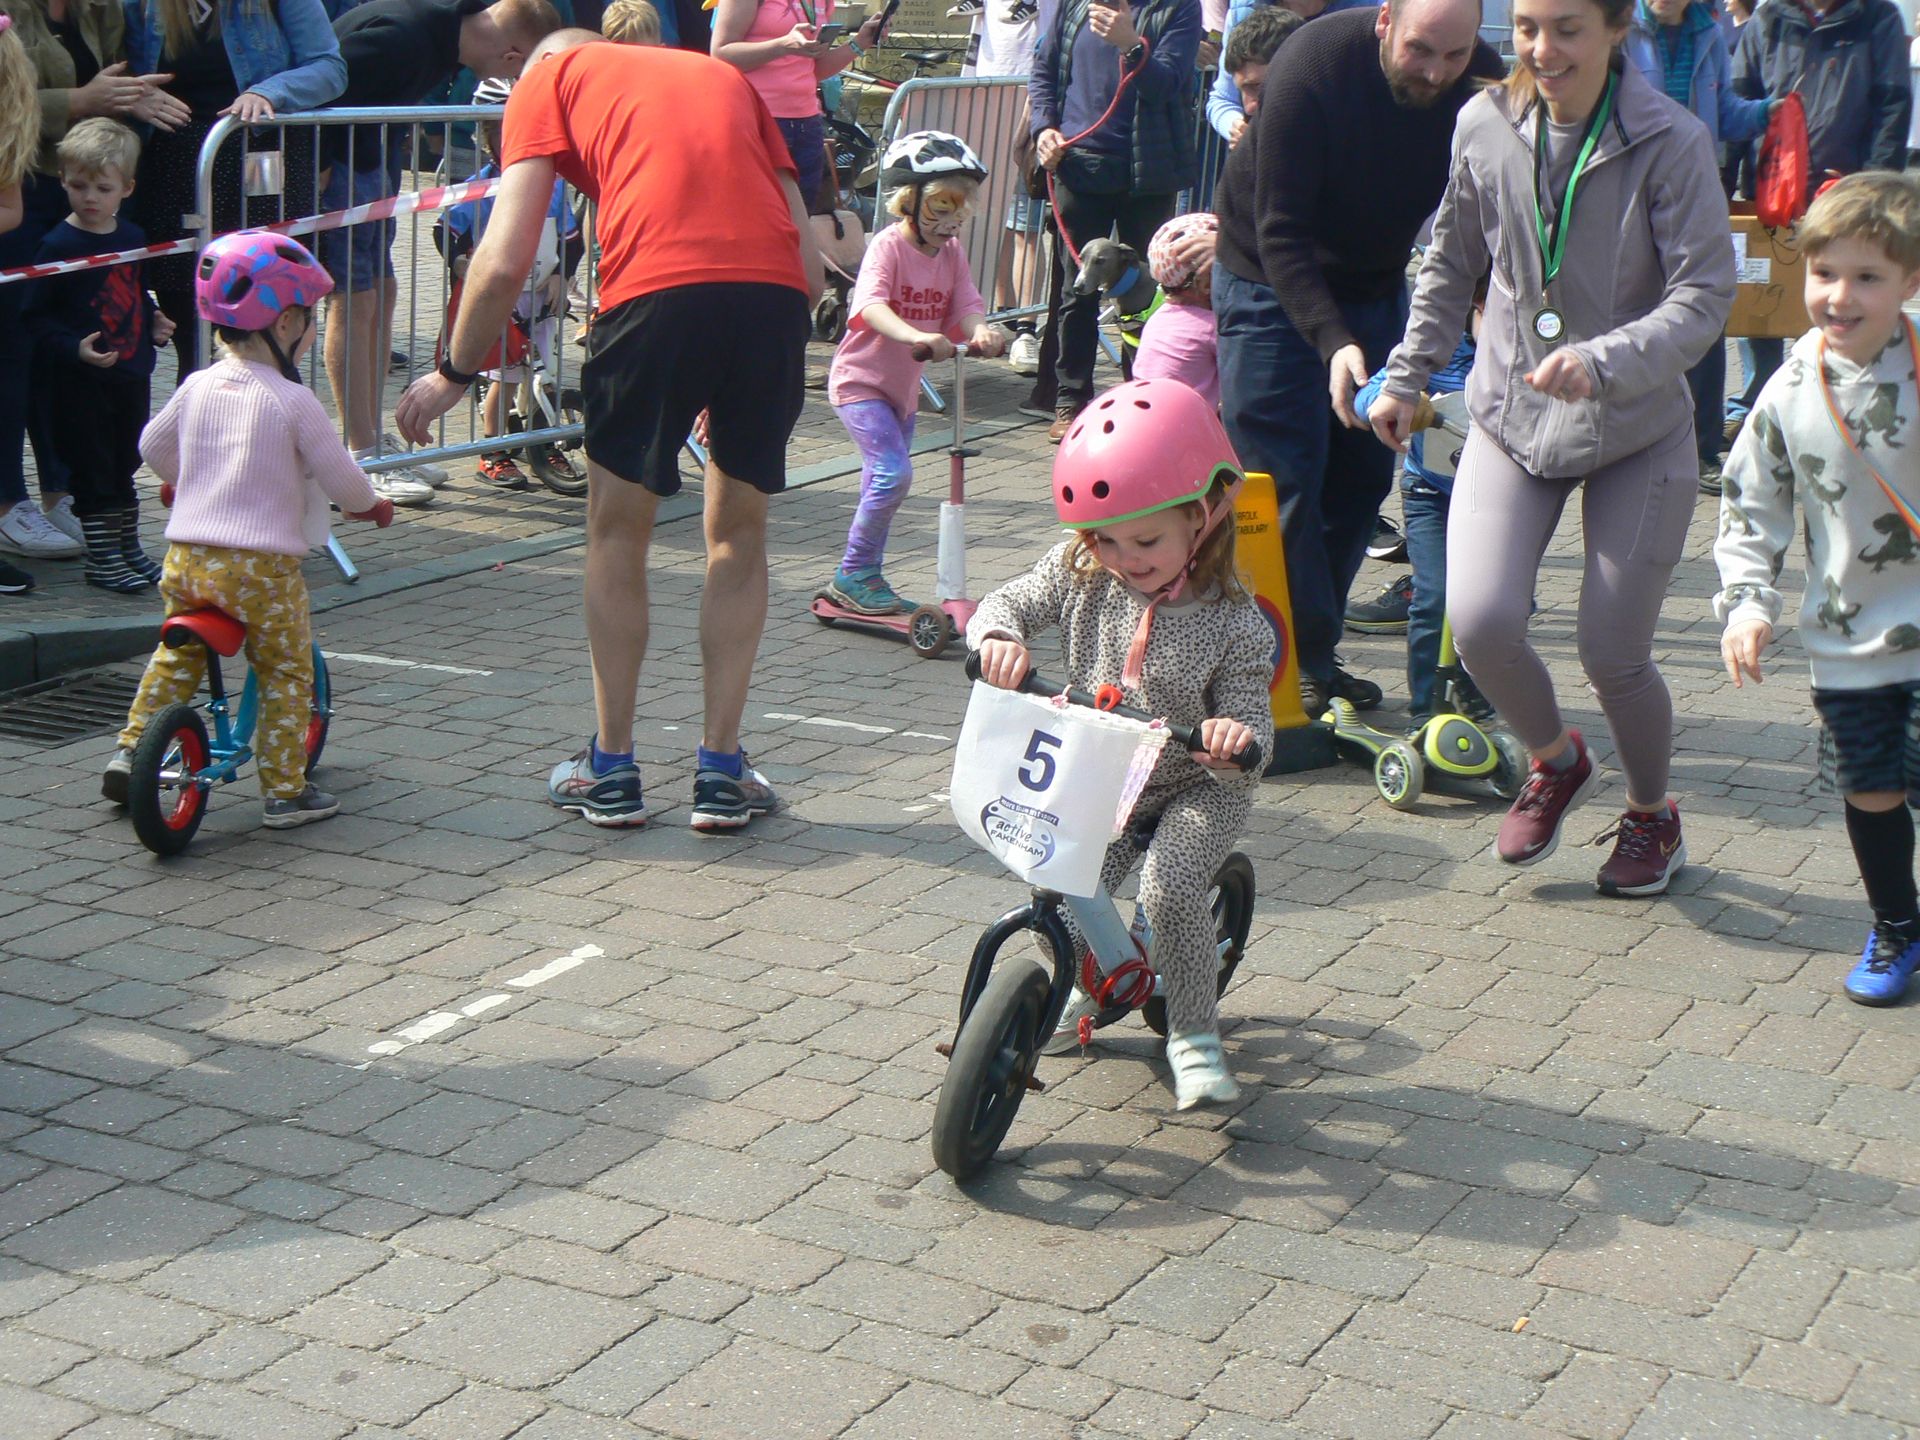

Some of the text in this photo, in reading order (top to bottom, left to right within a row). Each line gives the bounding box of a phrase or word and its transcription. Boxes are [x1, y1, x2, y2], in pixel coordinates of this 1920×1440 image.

[1236, 523, 1269, 535] TABULARY
[1018, 729, 1062, 792] 5
[990, 829, 1044, 858] FAKENHAM
[995, 820, 1032, 842] active
